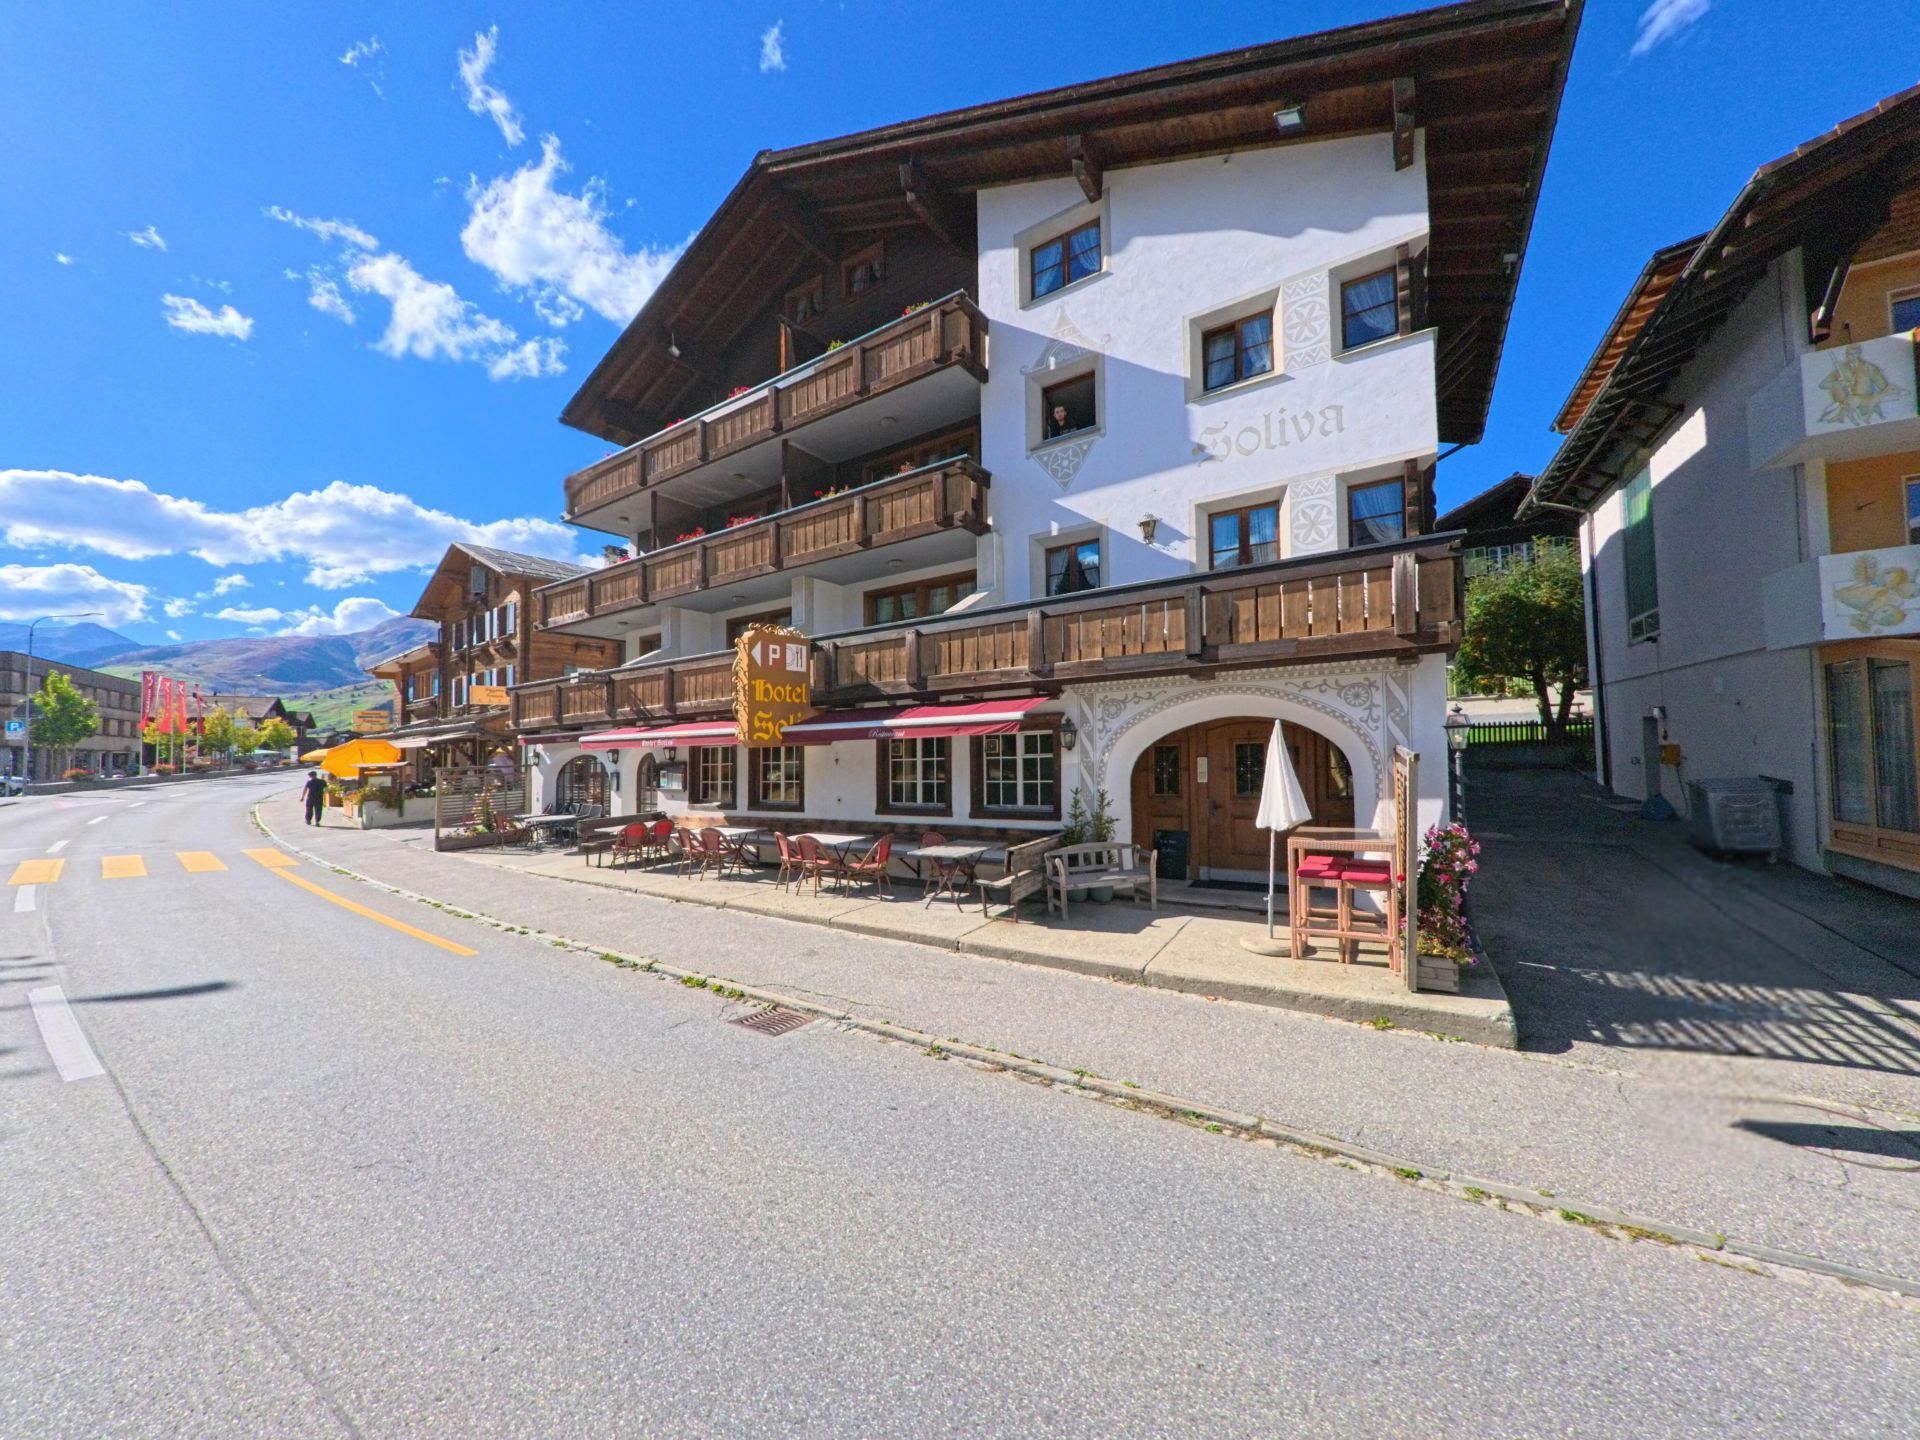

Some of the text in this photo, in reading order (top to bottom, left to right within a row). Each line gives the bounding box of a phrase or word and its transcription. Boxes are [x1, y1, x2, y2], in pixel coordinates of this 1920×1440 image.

[1194, 404, 1346, 467] Soliva
[768, 644, 781, 667] P
[751, 679, 807, 704] Hotel
